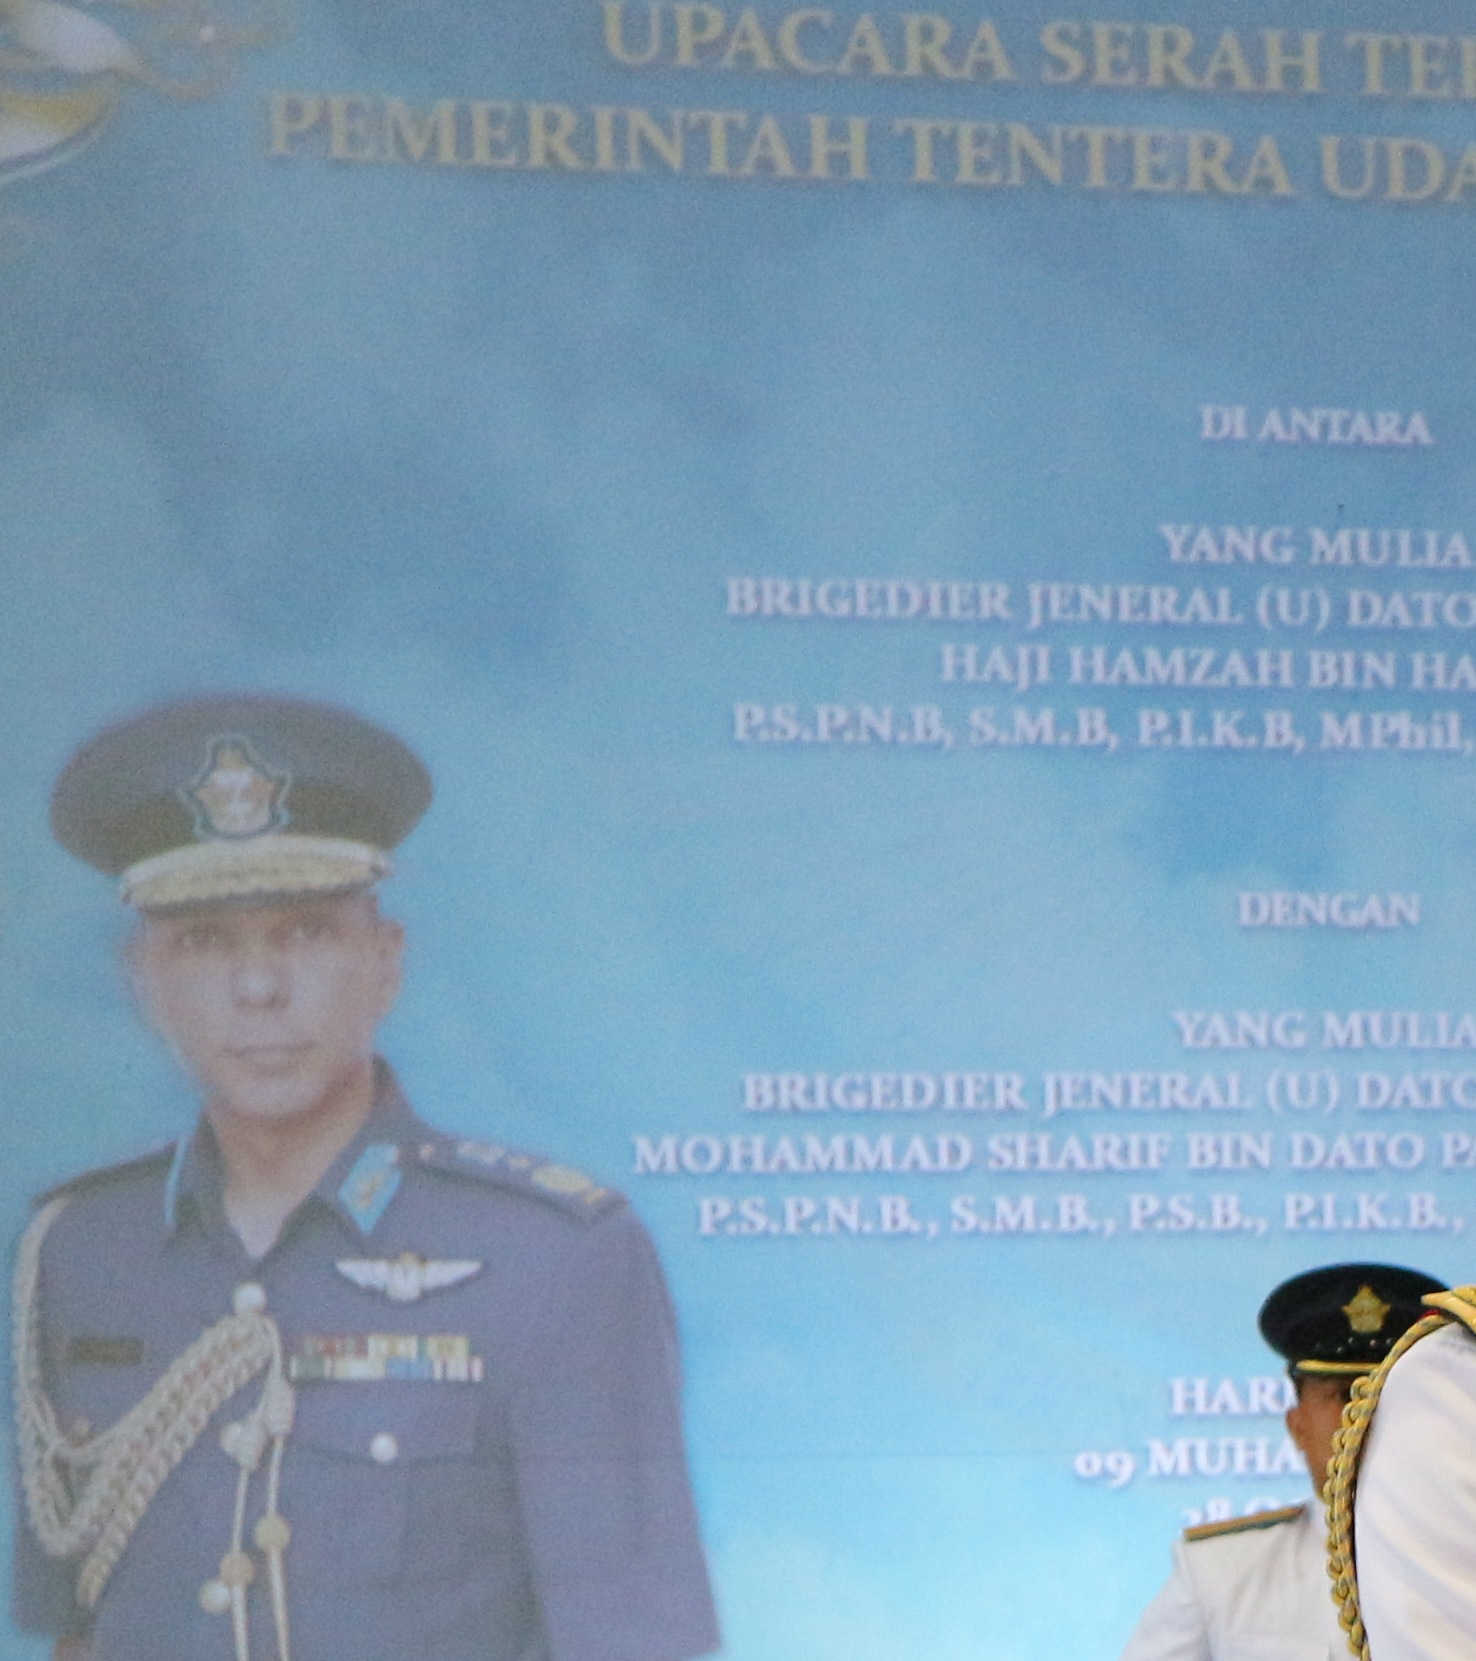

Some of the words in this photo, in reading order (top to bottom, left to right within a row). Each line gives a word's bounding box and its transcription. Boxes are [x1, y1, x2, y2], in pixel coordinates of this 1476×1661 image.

[603, 3, 1011, 81] UPACARA
[1040, 20, 1322, 95] SERAH
[267, 90, 872, 182] PEMERINTAH
[892, 116, 1291, 197] TENTERA
[1202, 405, 1248, 441] DI
[1258, 407, 1434, 447] ANTARA
[1160, 523, 1296, 566] YANG
[1309, 529, 1473, 569] MULIA
[726, 578, 1011, 619] BRIGEDIER
[1027, 582, 1244, 630] JENERAL
[1256, 585, 1331, 633] (U)
[941, 644, 1051, 692] HAJI
[1068, 647, 1295, 687] HAMZAH
[1309, 651, 1395, 689] BIN
[1239, 892, 1420, 928] DENGAN
[1174, 1012, 1305, 1049] YANG
[742, 1073, 1026, 1112] BRIGEDIER
[1041, 1073, 1258, 1118] JENERAL
[1265, 1072, 1339, 1117] (U)
[633, 1135, 973, 1174] MOHAMMAD
[988, 1133, 1172, 1173] SHARIF
[1187, 1132, 1272, 1170] BIN
[1290, 1131, 1425, 1170] DATO
[1074, 1452, 1135, 1488] 09
